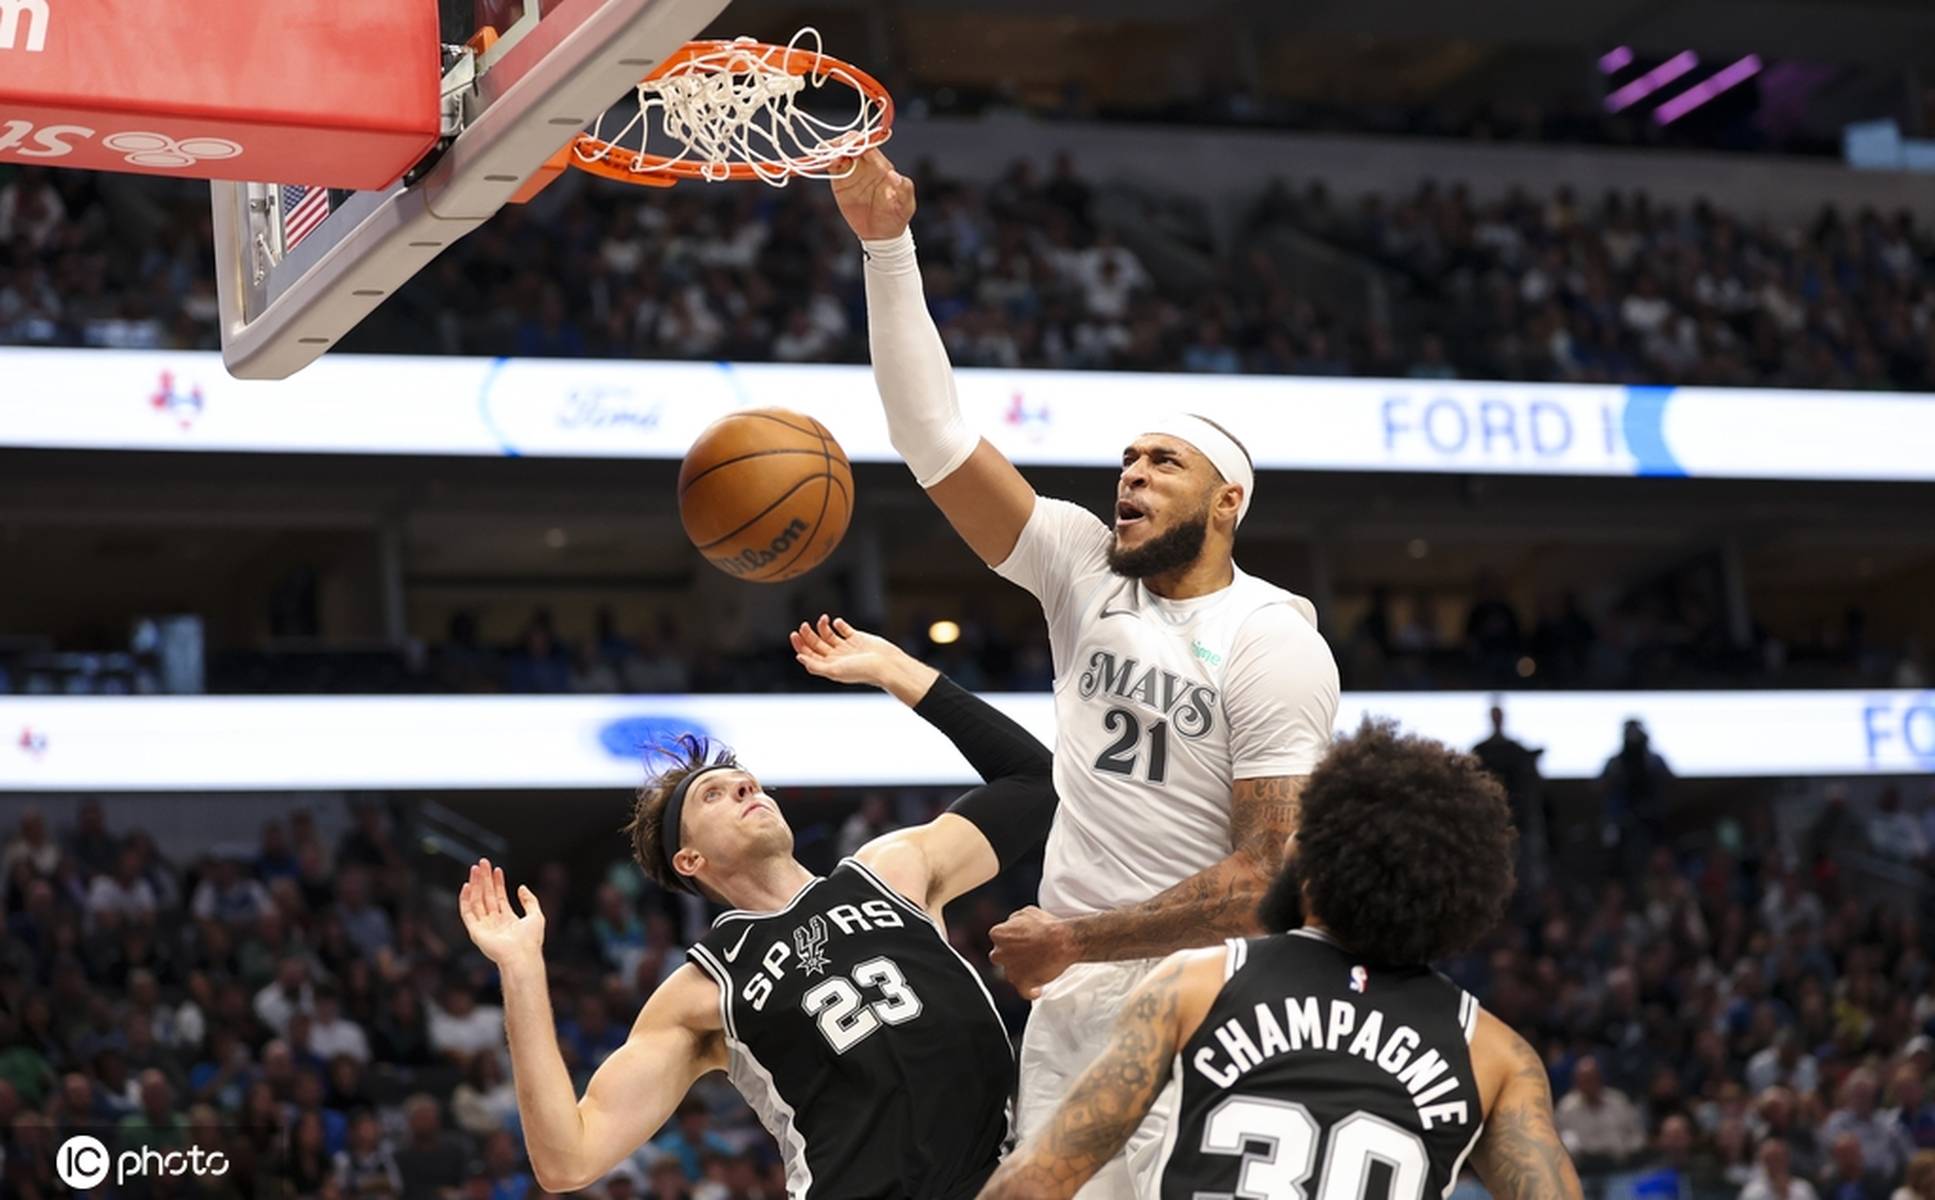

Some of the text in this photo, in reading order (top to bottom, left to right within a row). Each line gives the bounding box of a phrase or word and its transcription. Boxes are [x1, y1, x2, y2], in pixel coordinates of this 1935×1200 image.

[1380, 398, 1574, 456] FORD
[1079, 649, 1217, 739] MAVS
[1093, 707, 1169, 784] 21
[801, 955, 924, 1055] 23
[1193, 996, 1469, 1131] CHAMPAGNIE
[1192, 1093, 1431, 1200] 30
